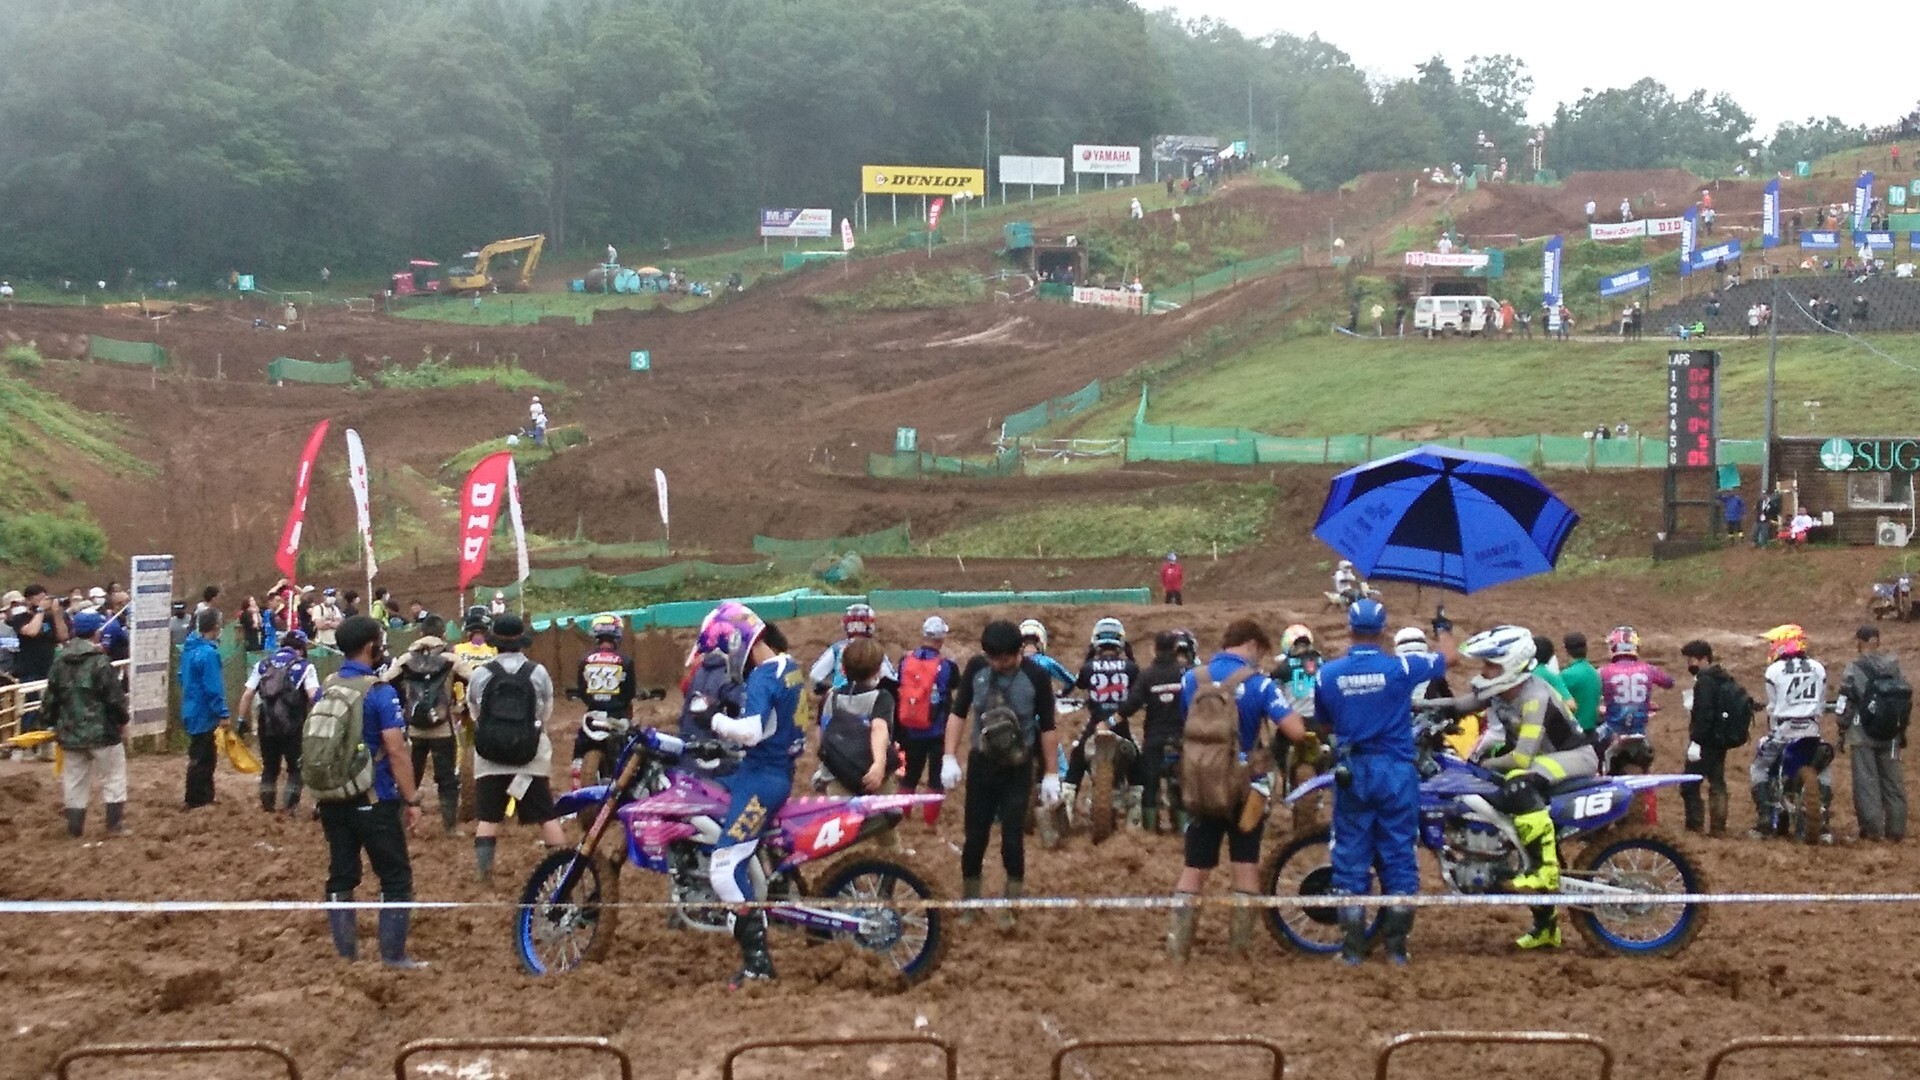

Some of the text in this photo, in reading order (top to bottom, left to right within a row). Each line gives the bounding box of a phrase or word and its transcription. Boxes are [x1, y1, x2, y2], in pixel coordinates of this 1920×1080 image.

[1093, 150, 1131, 161] YAMAHA
[1798, 161, 1808, 174] 7
[891, 174, 972, 187] DUNLOP
[1890, 186, 1906, 203] 10
[1659, 221, 1681, 232] DID
[635, 351, 646, 369] 3
[1668, 353, 1690, 366] LAPS
[1671, 369, 1676, 382] 1
[1670, 386, 1677, 399] 2
[1670, 402, 1677, 415] 3
[1670, 419, 1677, 431] 4
[899, 428, 915, 450] 11
[1670, 435, 1677, 448] 5
[1670, 452, 1677, 464] 6
[1857, 440, 1920, 472] SUG
[585, 665, 621, 691] 33
[1348, 673, 1387, 687] YAMAHA
[1611, 673, 1649, 704] 36
[1573, 791, 1614, 820] 16
[812, 817, 845, 850] 4
